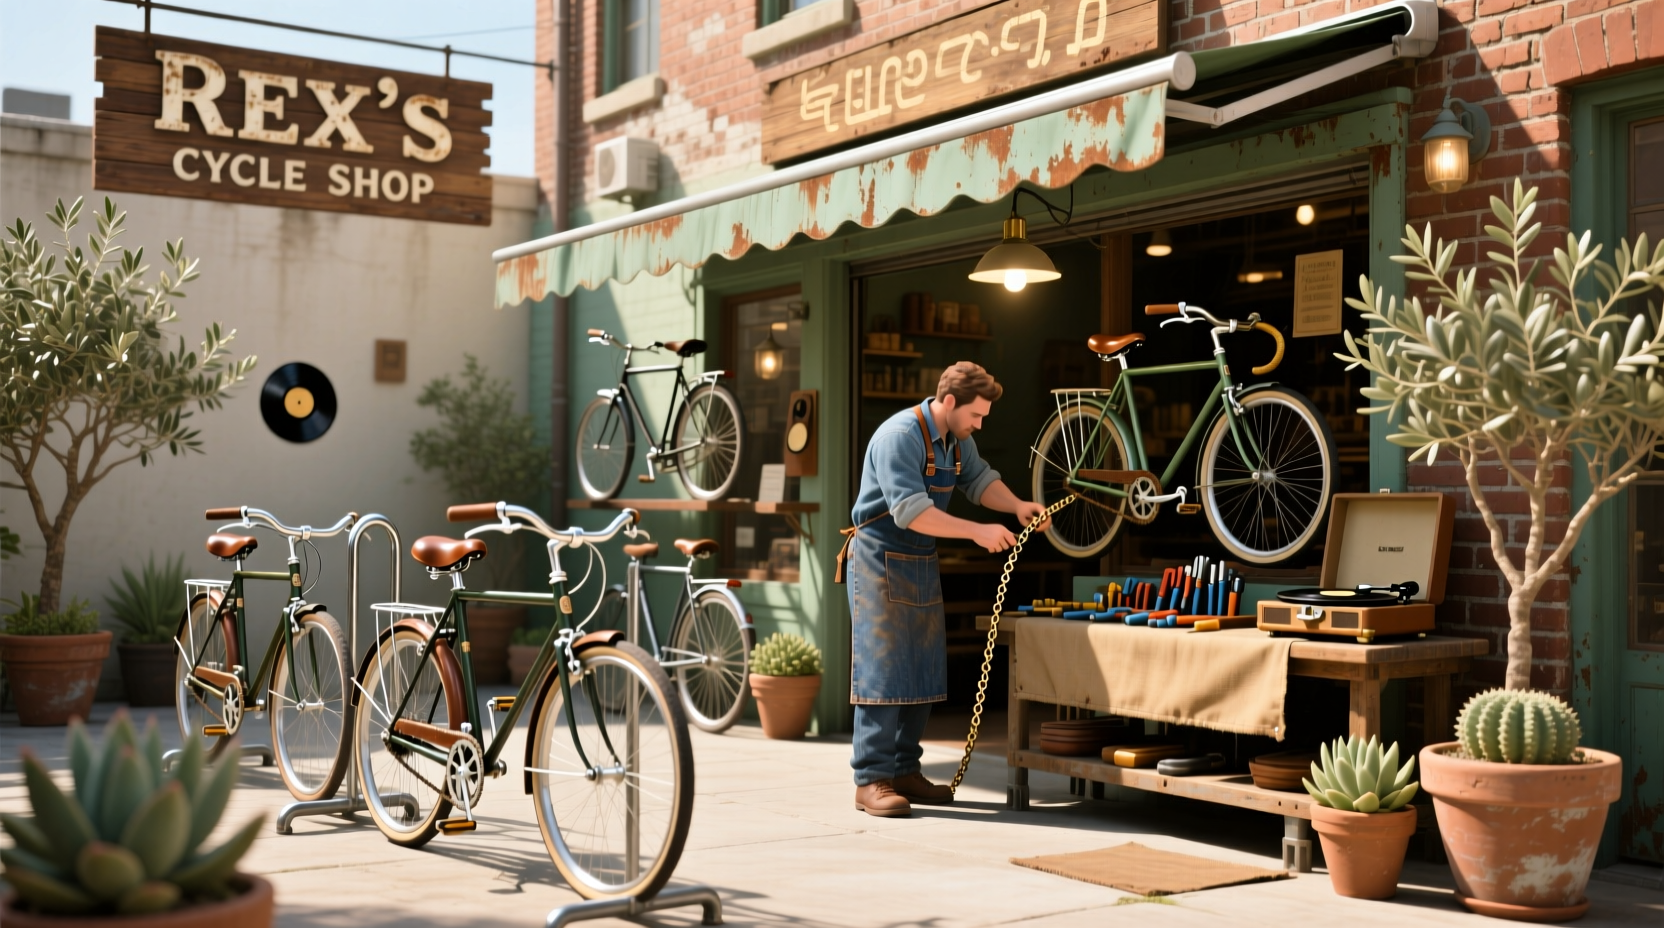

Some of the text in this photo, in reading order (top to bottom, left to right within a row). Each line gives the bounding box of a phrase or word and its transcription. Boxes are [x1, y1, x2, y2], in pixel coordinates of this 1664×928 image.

[154, 49, 453, 163] REX'S
[172, 147, 435, 203] CYCLE SHOP
